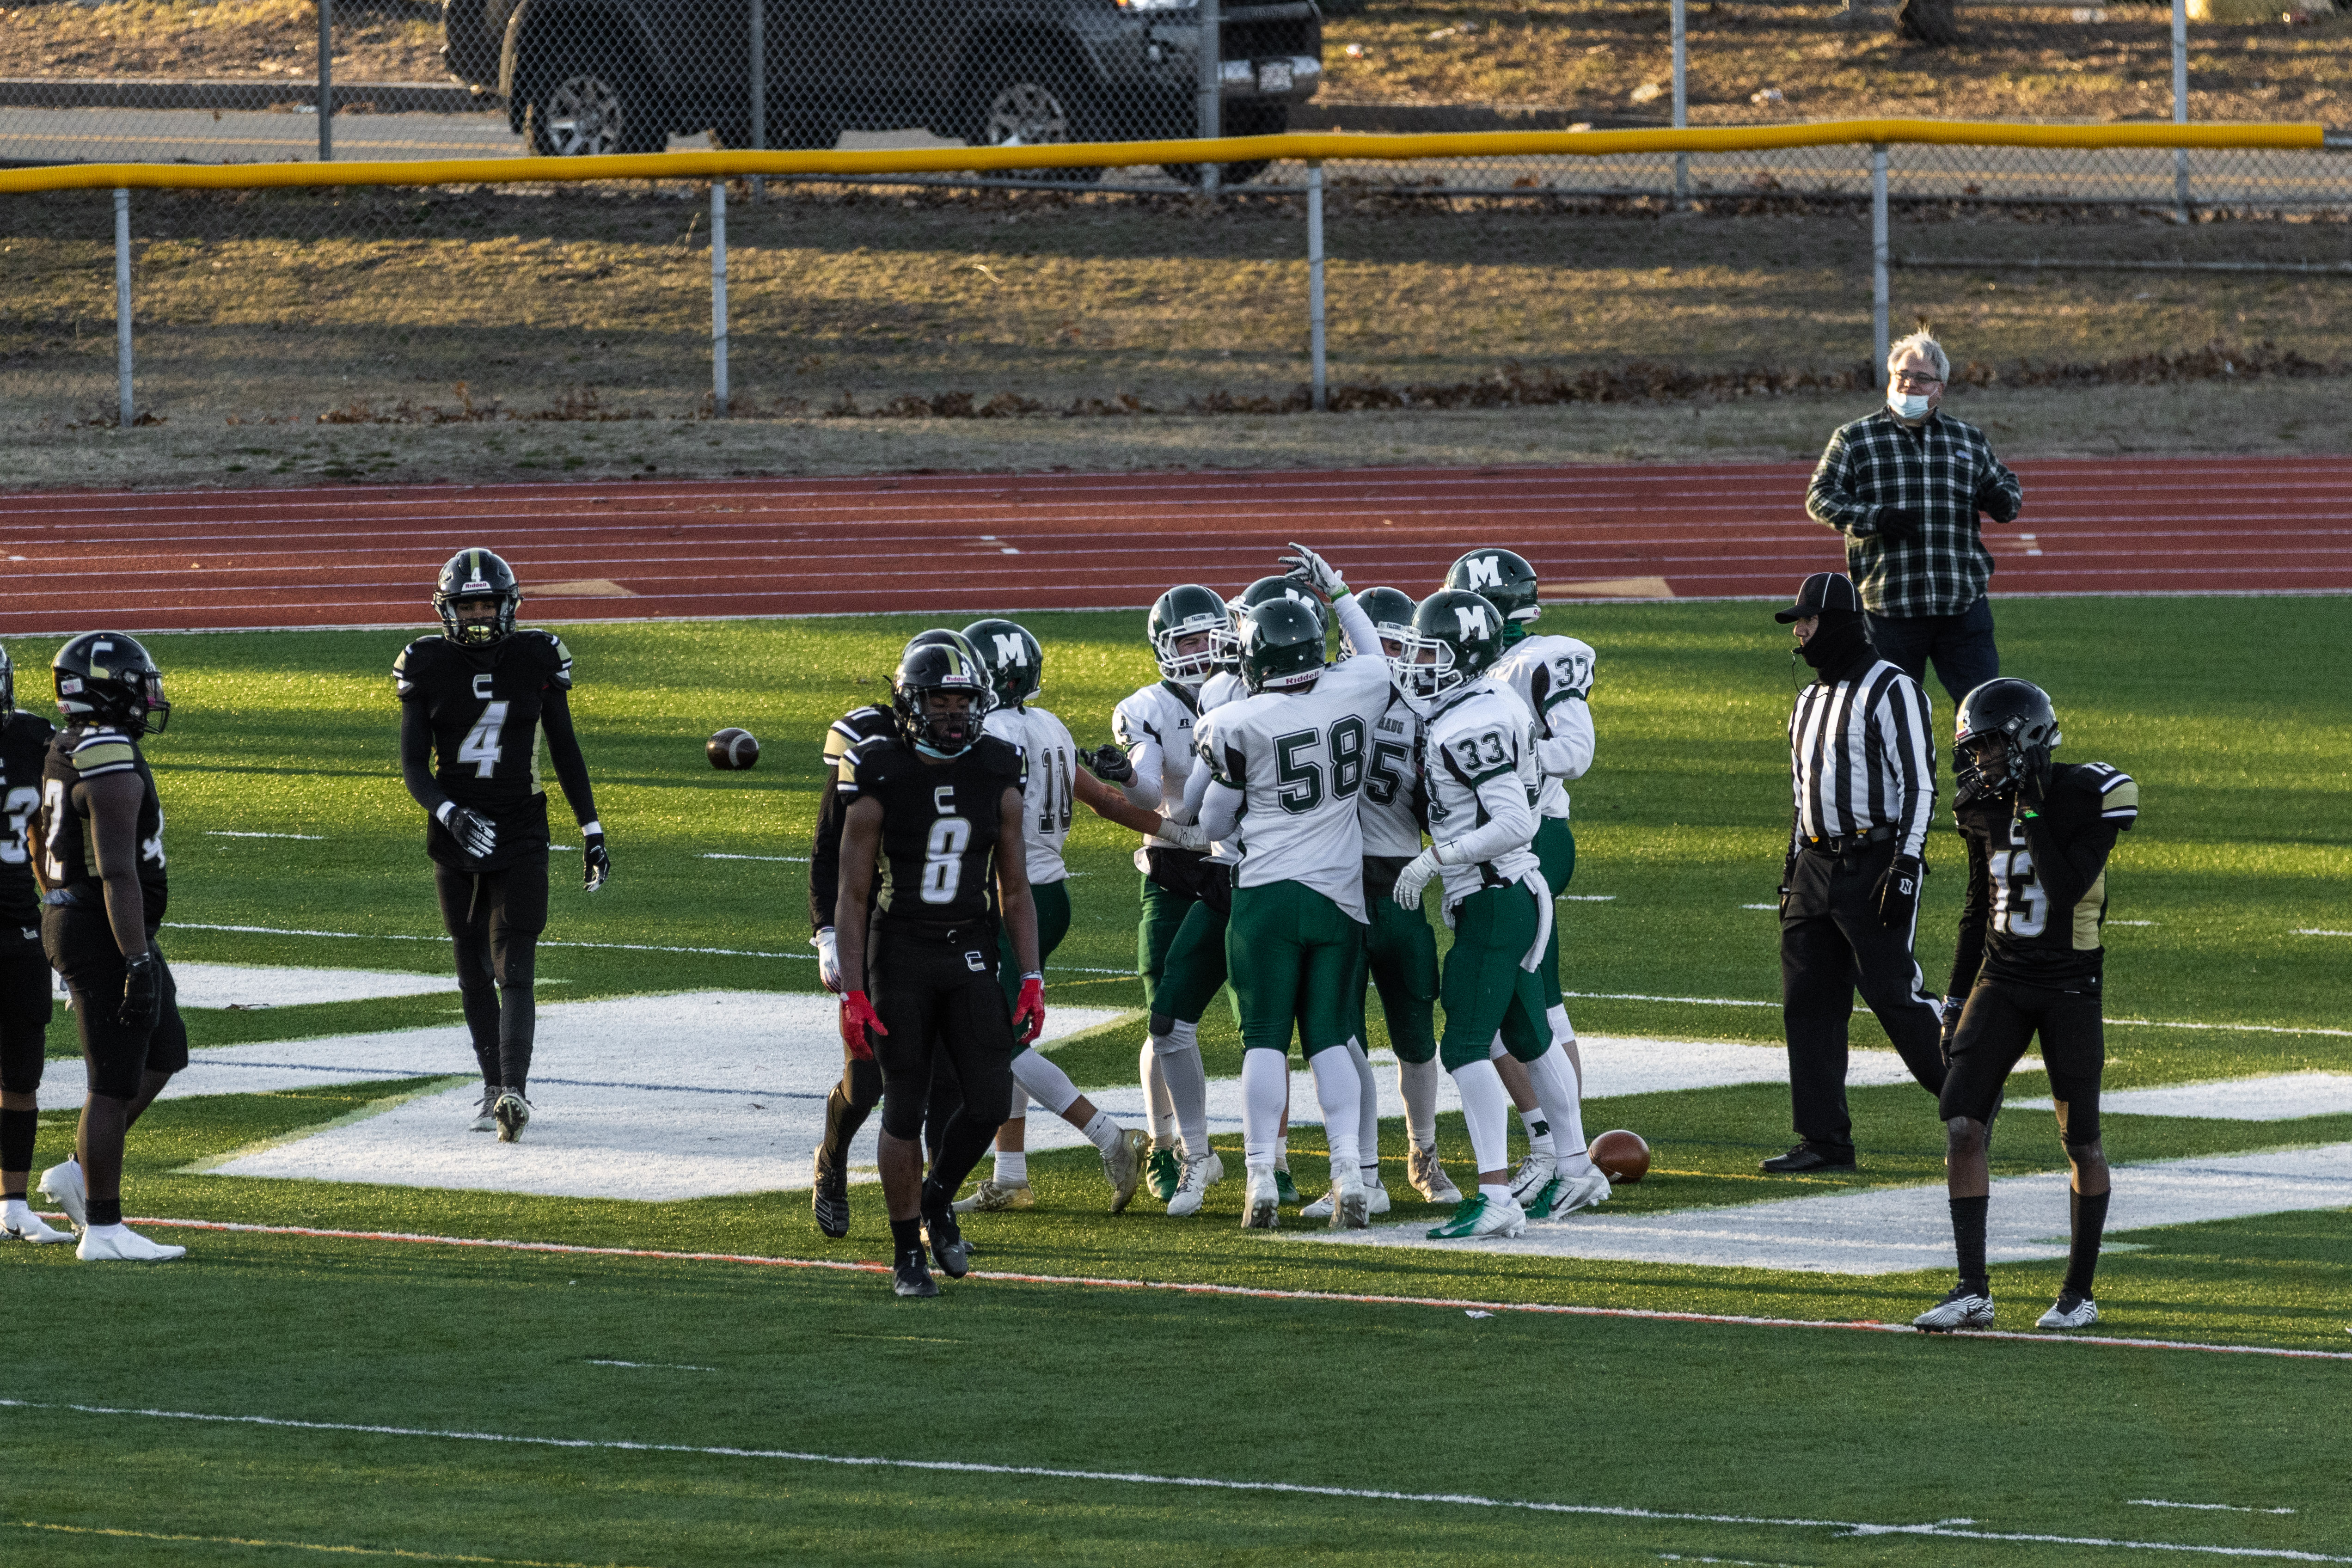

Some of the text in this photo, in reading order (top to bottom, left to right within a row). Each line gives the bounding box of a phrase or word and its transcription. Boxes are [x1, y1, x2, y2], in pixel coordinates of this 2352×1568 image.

[471, 567, 481, 582] 4
[1466, 556, 1502, 592] M
[1455, 605, 1489, 643] M
[992, 633, 1027, 668] M
[1286, 670, 1319, 685] Riddell
[1555, 655, 1589, 689] 37
[457, 701, 509, 778] 4
[1458, 731, 1506, 771] 33
[1273, 713, 1366, 815] 58
[1040, 746, 1074, 833] 10
[920, 817, 971, 904] 8
[1989, 850, 2049, 938] 13
